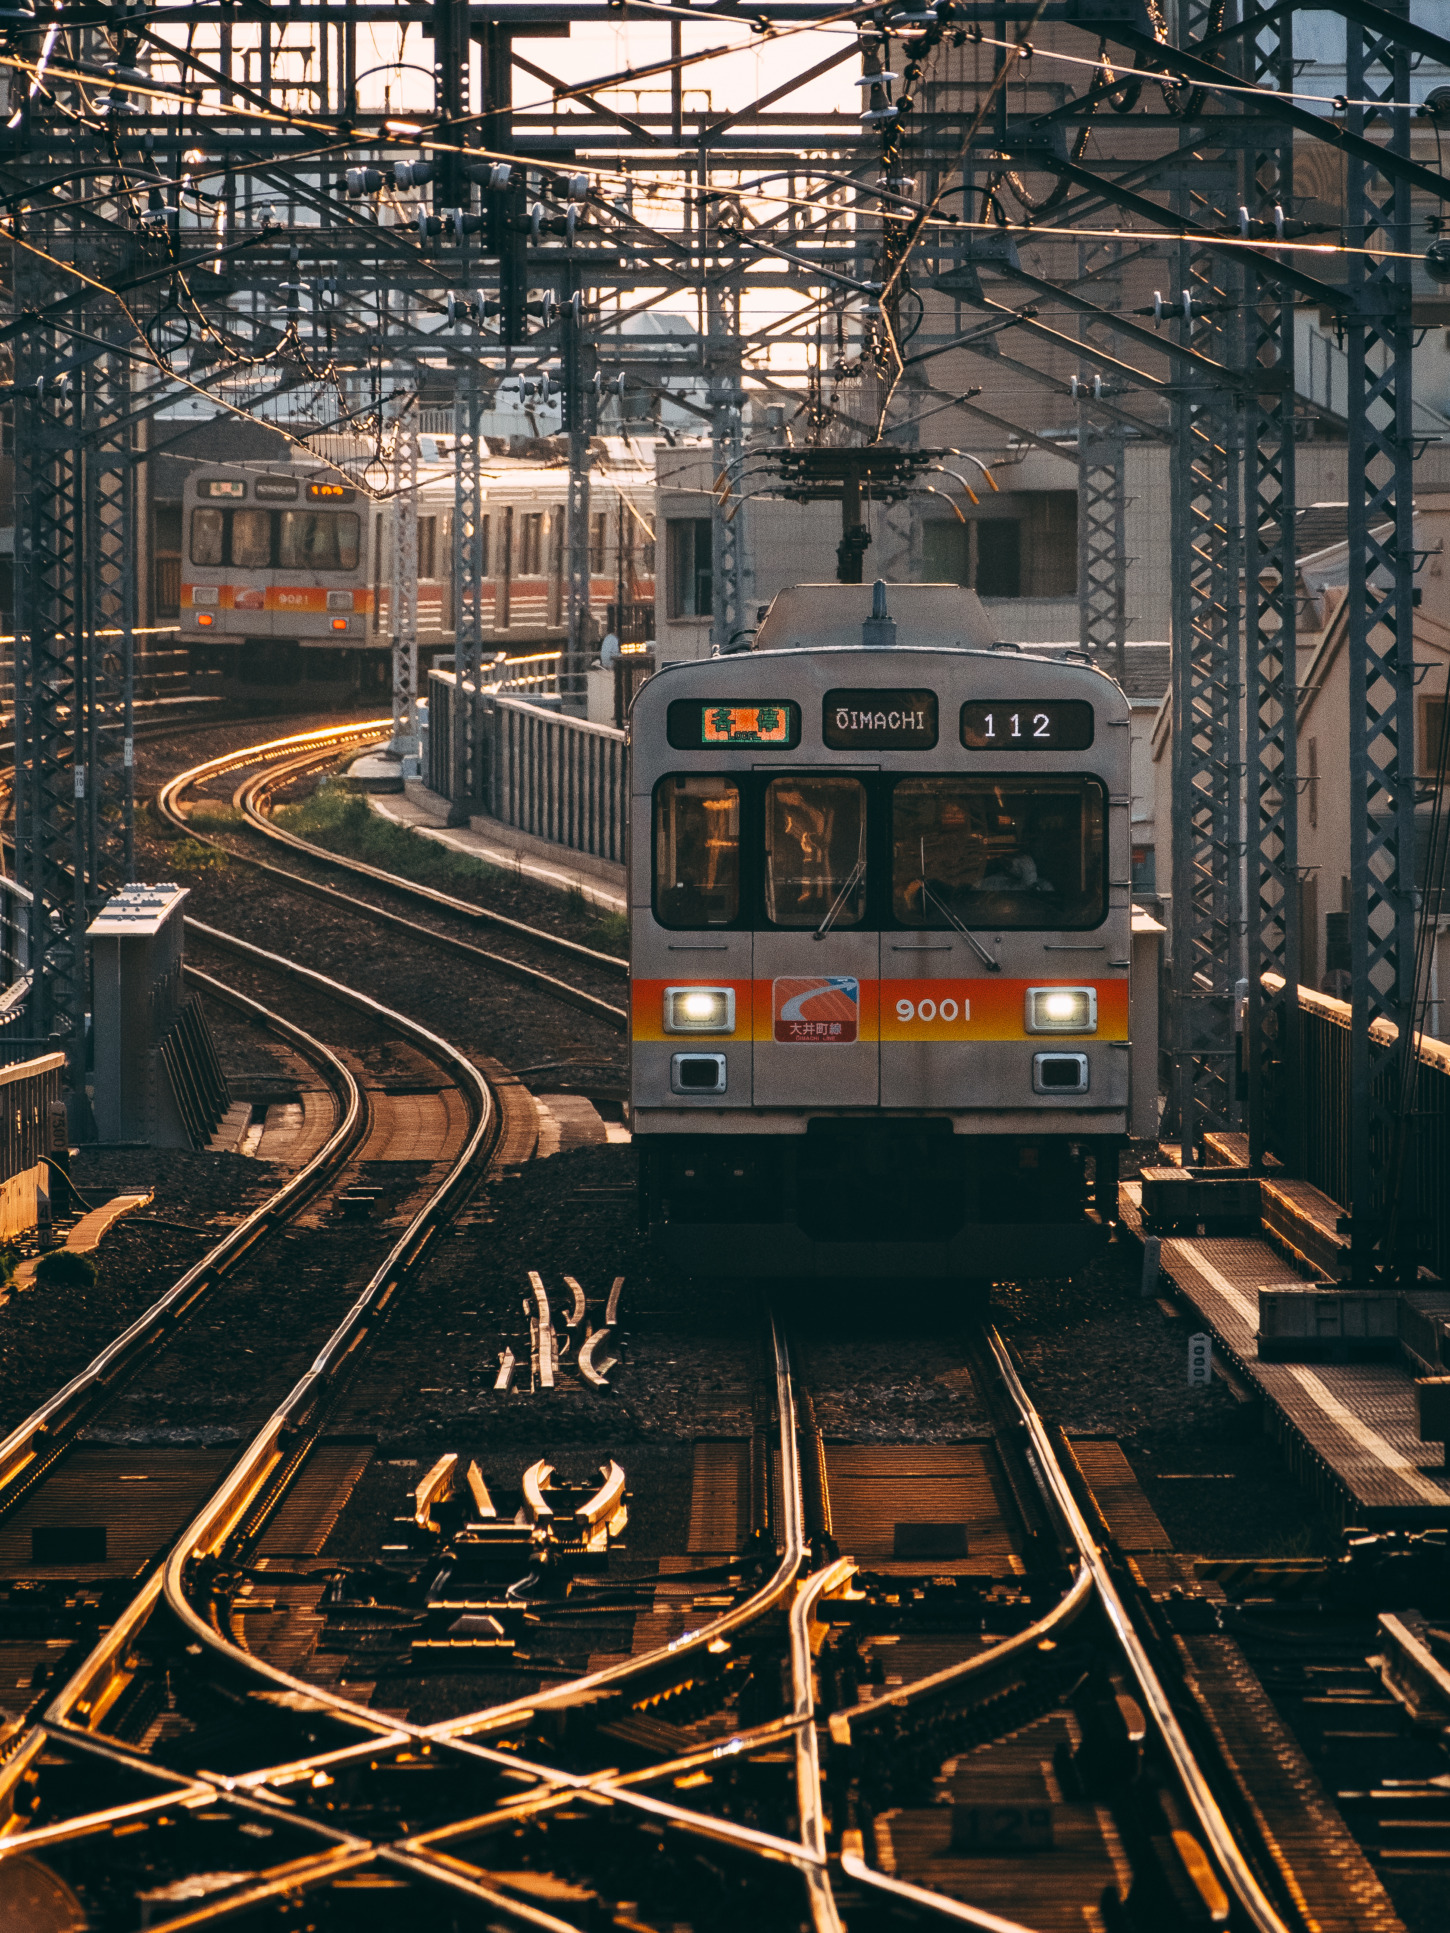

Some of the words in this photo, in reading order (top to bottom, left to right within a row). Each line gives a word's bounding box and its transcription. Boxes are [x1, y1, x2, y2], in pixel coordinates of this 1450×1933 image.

[836, 708, 924, 730] ŌIMACHI
[985, 713, 1050, 737] 112
[896, 998, 970, 1021] 9001
[790, 1022, 841, 1035] 大井町線
